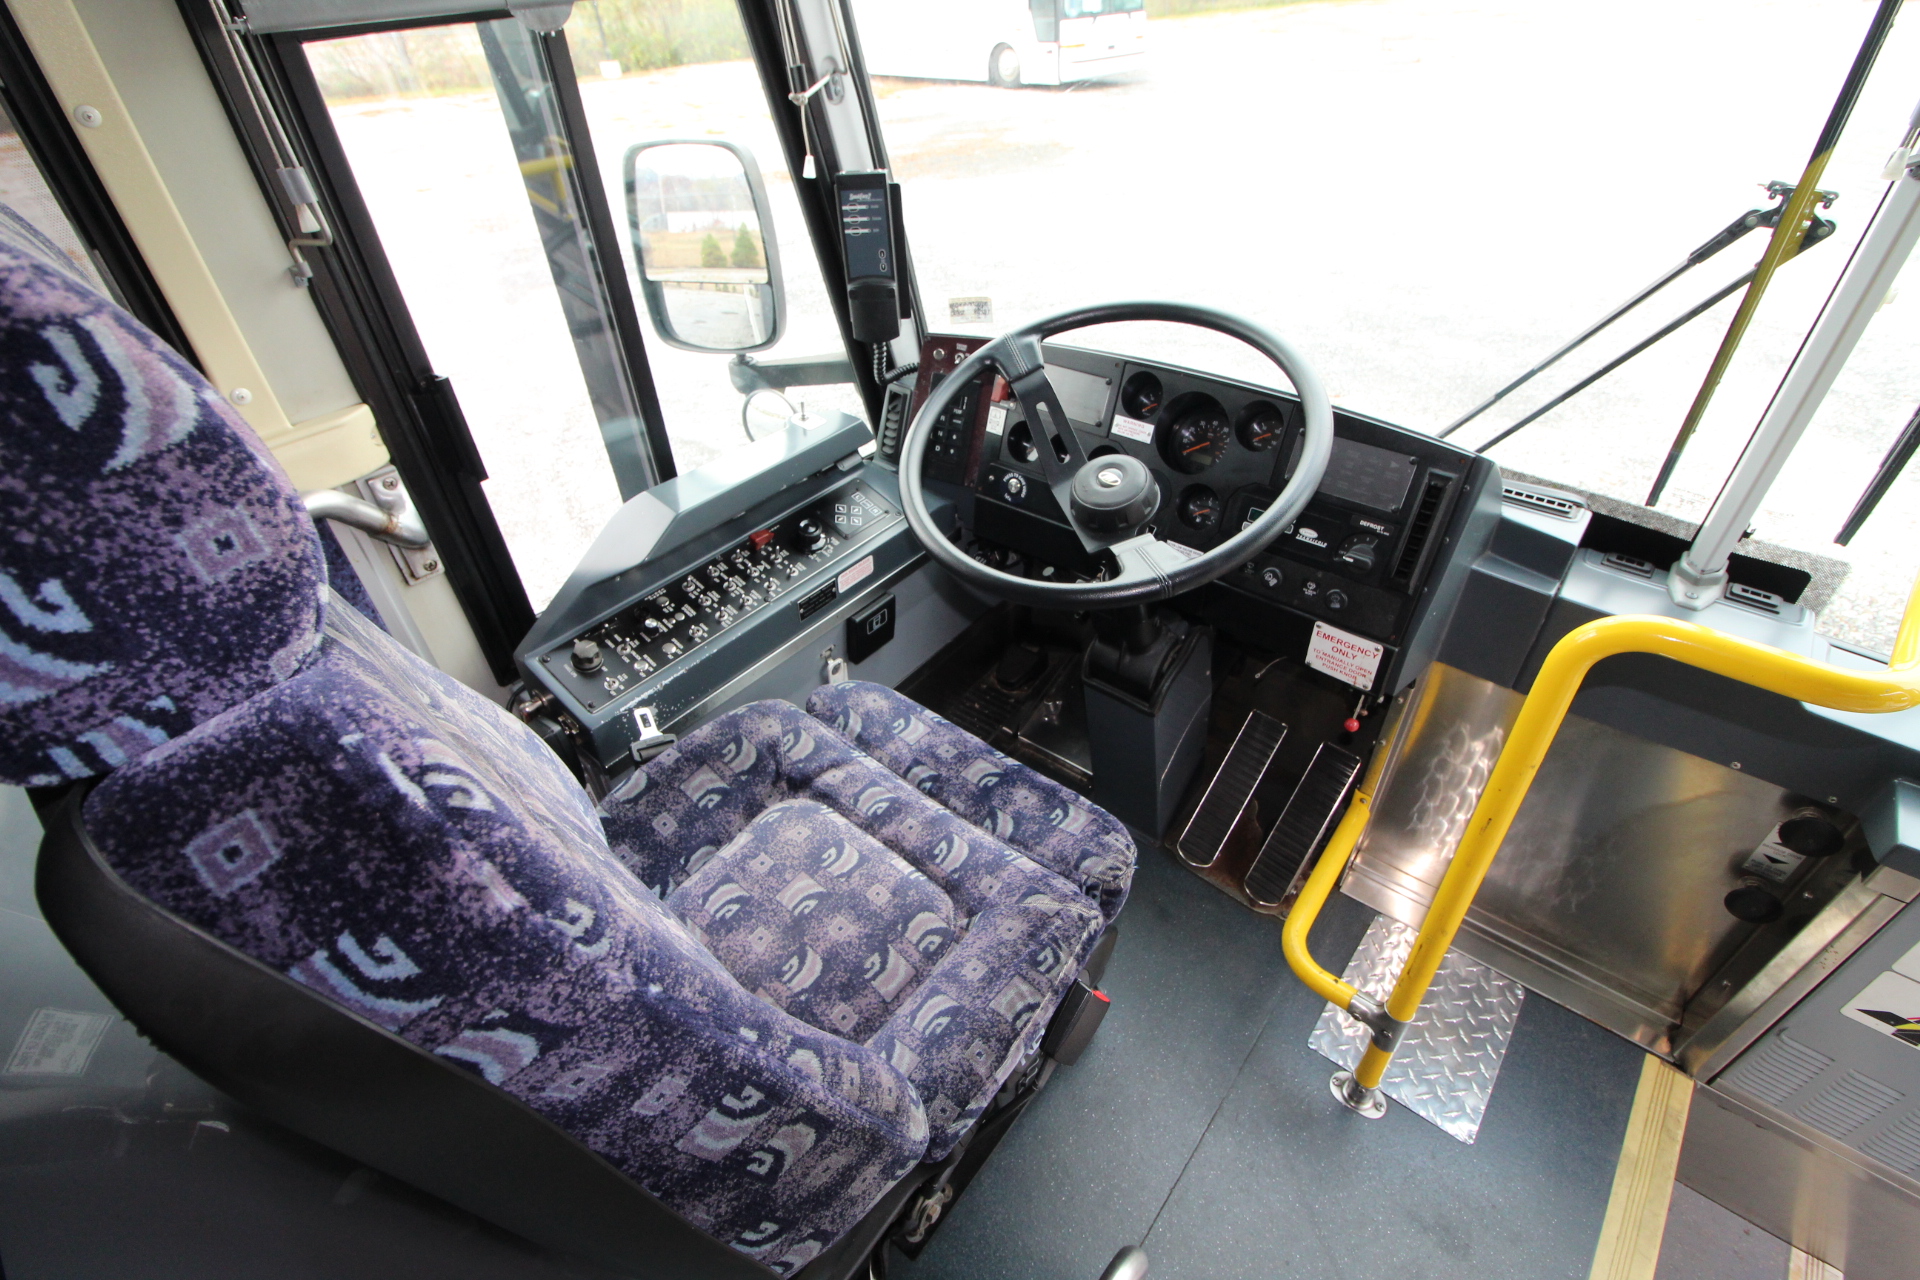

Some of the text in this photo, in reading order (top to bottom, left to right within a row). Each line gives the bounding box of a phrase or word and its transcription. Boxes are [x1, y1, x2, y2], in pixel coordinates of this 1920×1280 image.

[1360, 520, 1385, 531] DEFROST
[1316, 630, 1379, 659] EMERGENCY
[1331, 646, 1357, 660] ONLY
[1316, 655, 1367, 678] ENTRANCE DOOR
[1322, 650, 1355, 667] MANUALLY
[1355, 665, 1373, 675] OPEN
[1322, 663, 1357, 679] PUSH KNOB
